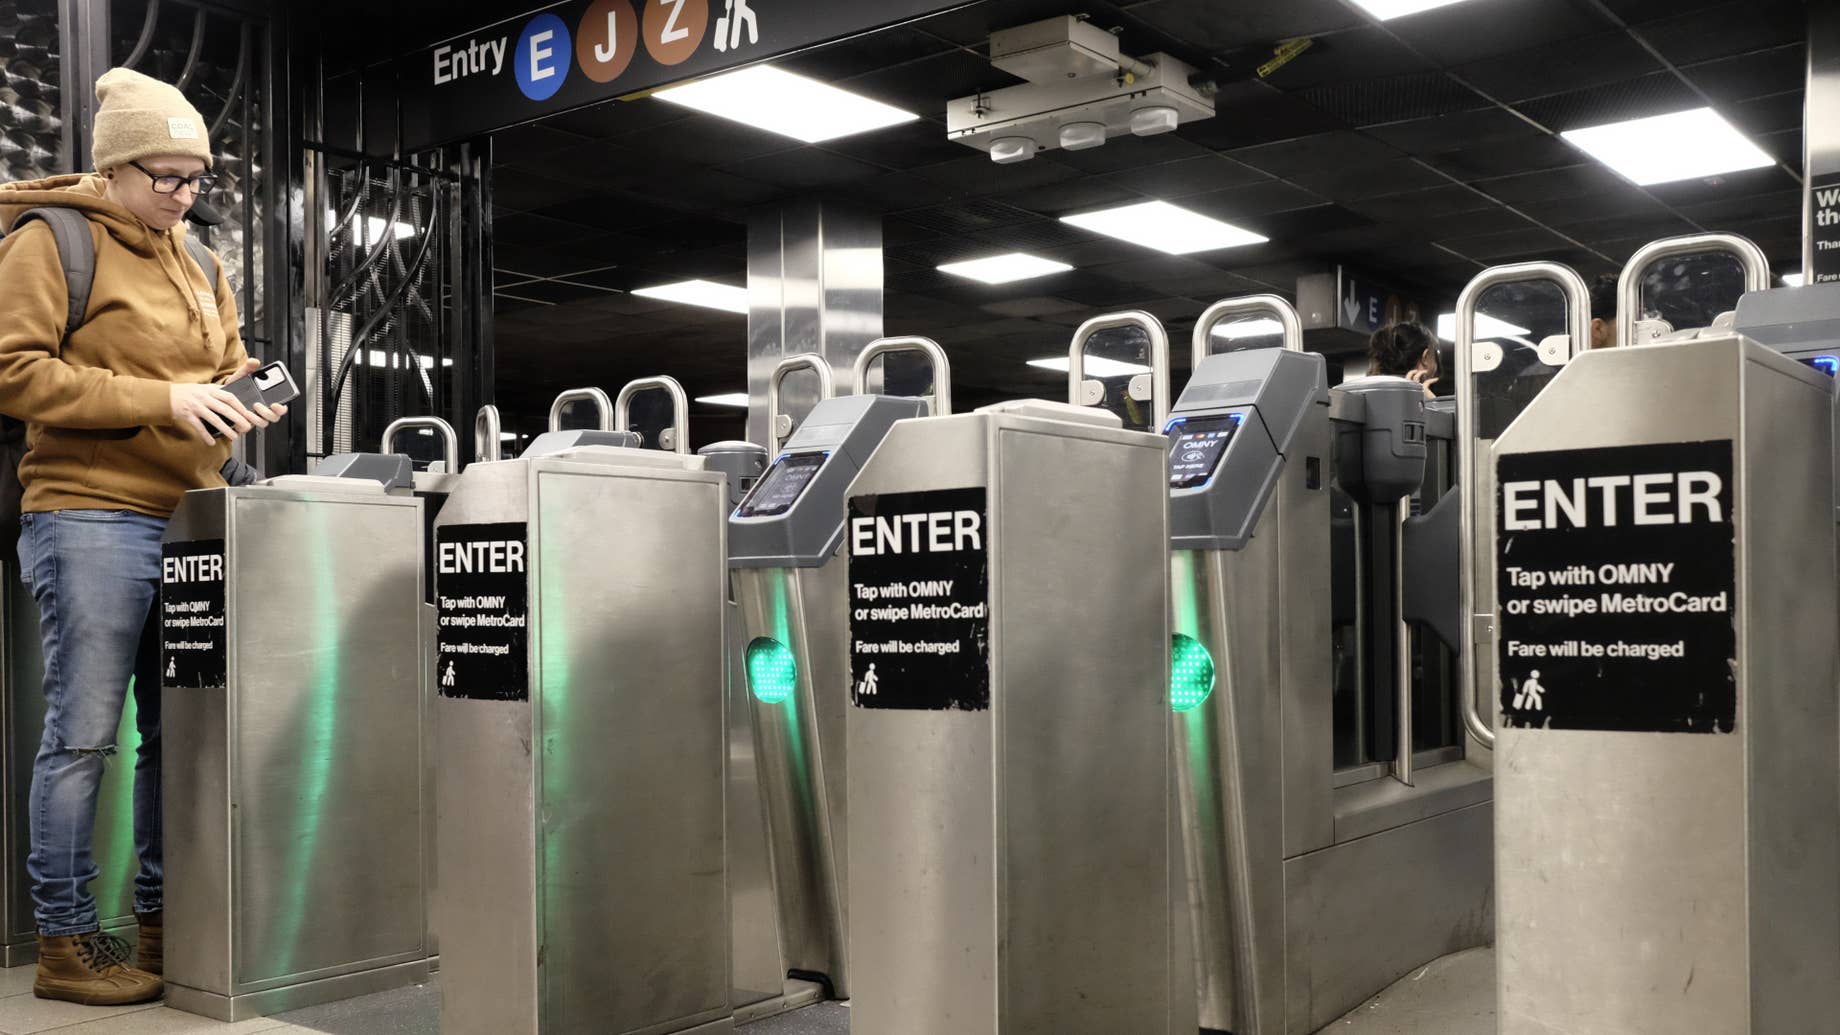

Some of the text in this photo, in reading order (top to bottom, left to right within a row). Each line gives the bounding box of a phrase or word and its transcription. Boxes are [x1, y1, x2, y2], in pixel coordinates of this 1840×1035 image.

[433, 0, 689, 86] Entry E J Z
[1816, 189, 1840, 207] W
[1815, 208, 1840, 226] th
[1816, 240, 1840, 250] Tha
[1369, 296, 1378, 323] E
[1503, 470, 1723, 531] ENTER
[852, 510, 981, 556] ENTER
[439, 540, 524, 574] ENTER
[163, 554, 223, 584] ENTER
[1505, 563, 1674, 590] Tap with OMNY
[854, 580, 953, 601] Tap with OMNY
[164, 601, 210, 615] Tap with OMNY
[440, 596, 506, 611] Tap with OMNY
[854, 602, 984, 622] or swipe MetroCard
[1506, 591, 1727, 617] or swipe MetroCard
[164, 616, 224, 628] or swipe MetroCard
[440, 614, 525, 628] or swipe MetroCard
[165, 641, 213, 651] Fare will be charged
[440, 642, 509, 656] Fare will be charged
[855, 640, 960, 656] Fare will be charged
[1507, 640, 1684, 660] Fare will be charged
